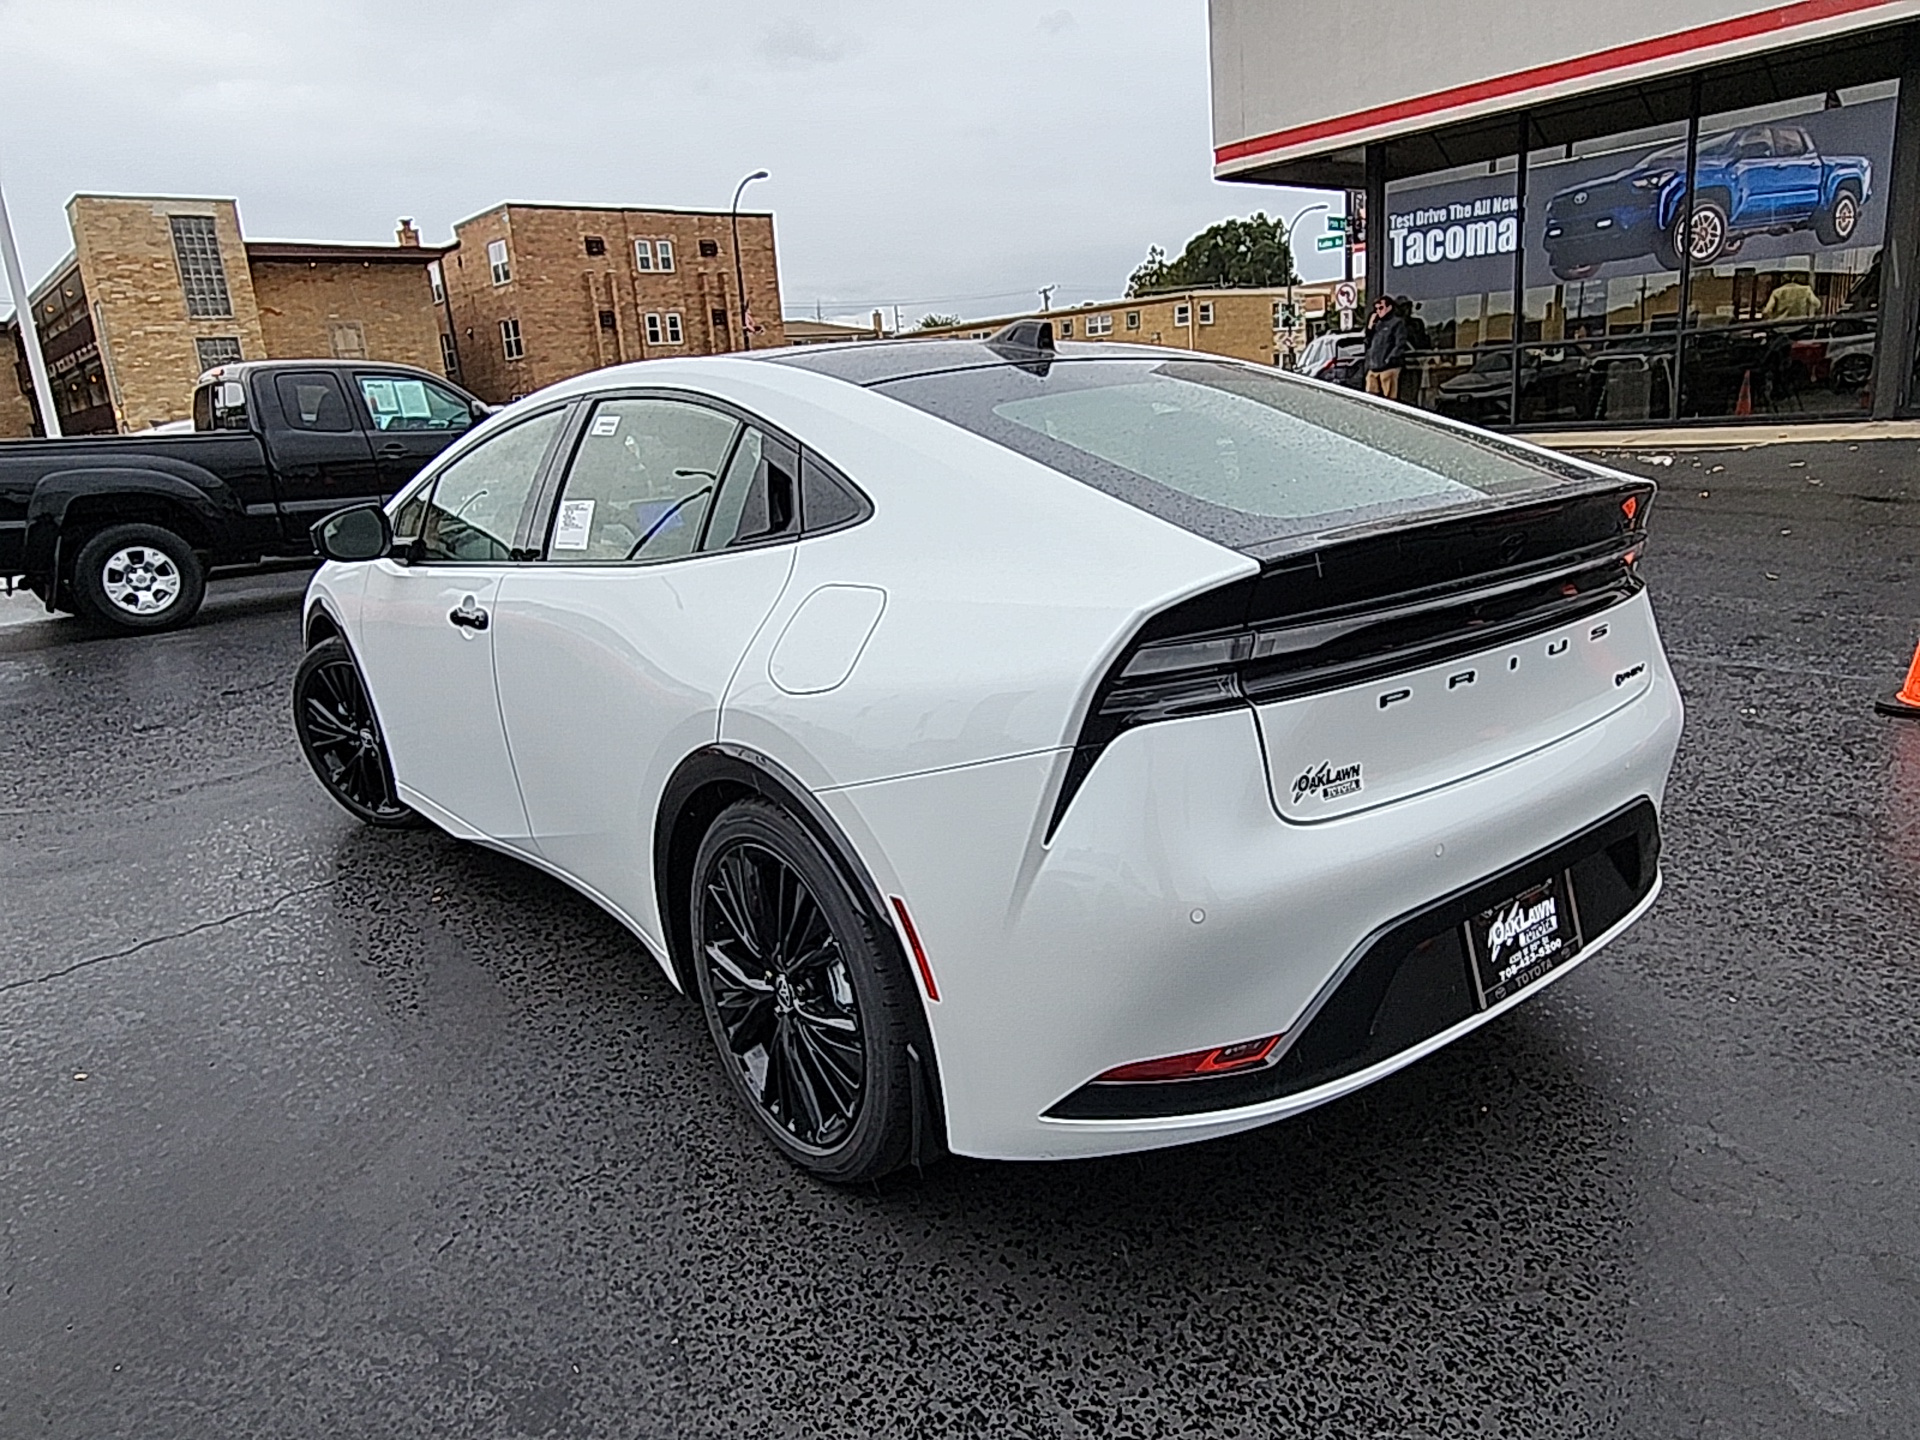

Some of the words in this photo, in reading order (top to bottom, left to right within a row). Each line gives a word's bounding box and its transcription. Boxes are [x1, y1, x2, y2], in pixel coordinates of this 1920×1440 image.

[1389, 214, 1414, 229] Test
[1416, 208, 1447, 227] Drive
[1449, 203, 1472, 221] The
[1474, 199, 1491, 216] All
[1493, 196, 1518, 213] New
[1389, 217, 1518, 267] Tacoma
[1379, 623, 1609, 709] PRIUS
[1515, 958, 1553, 987] TOYOTA
